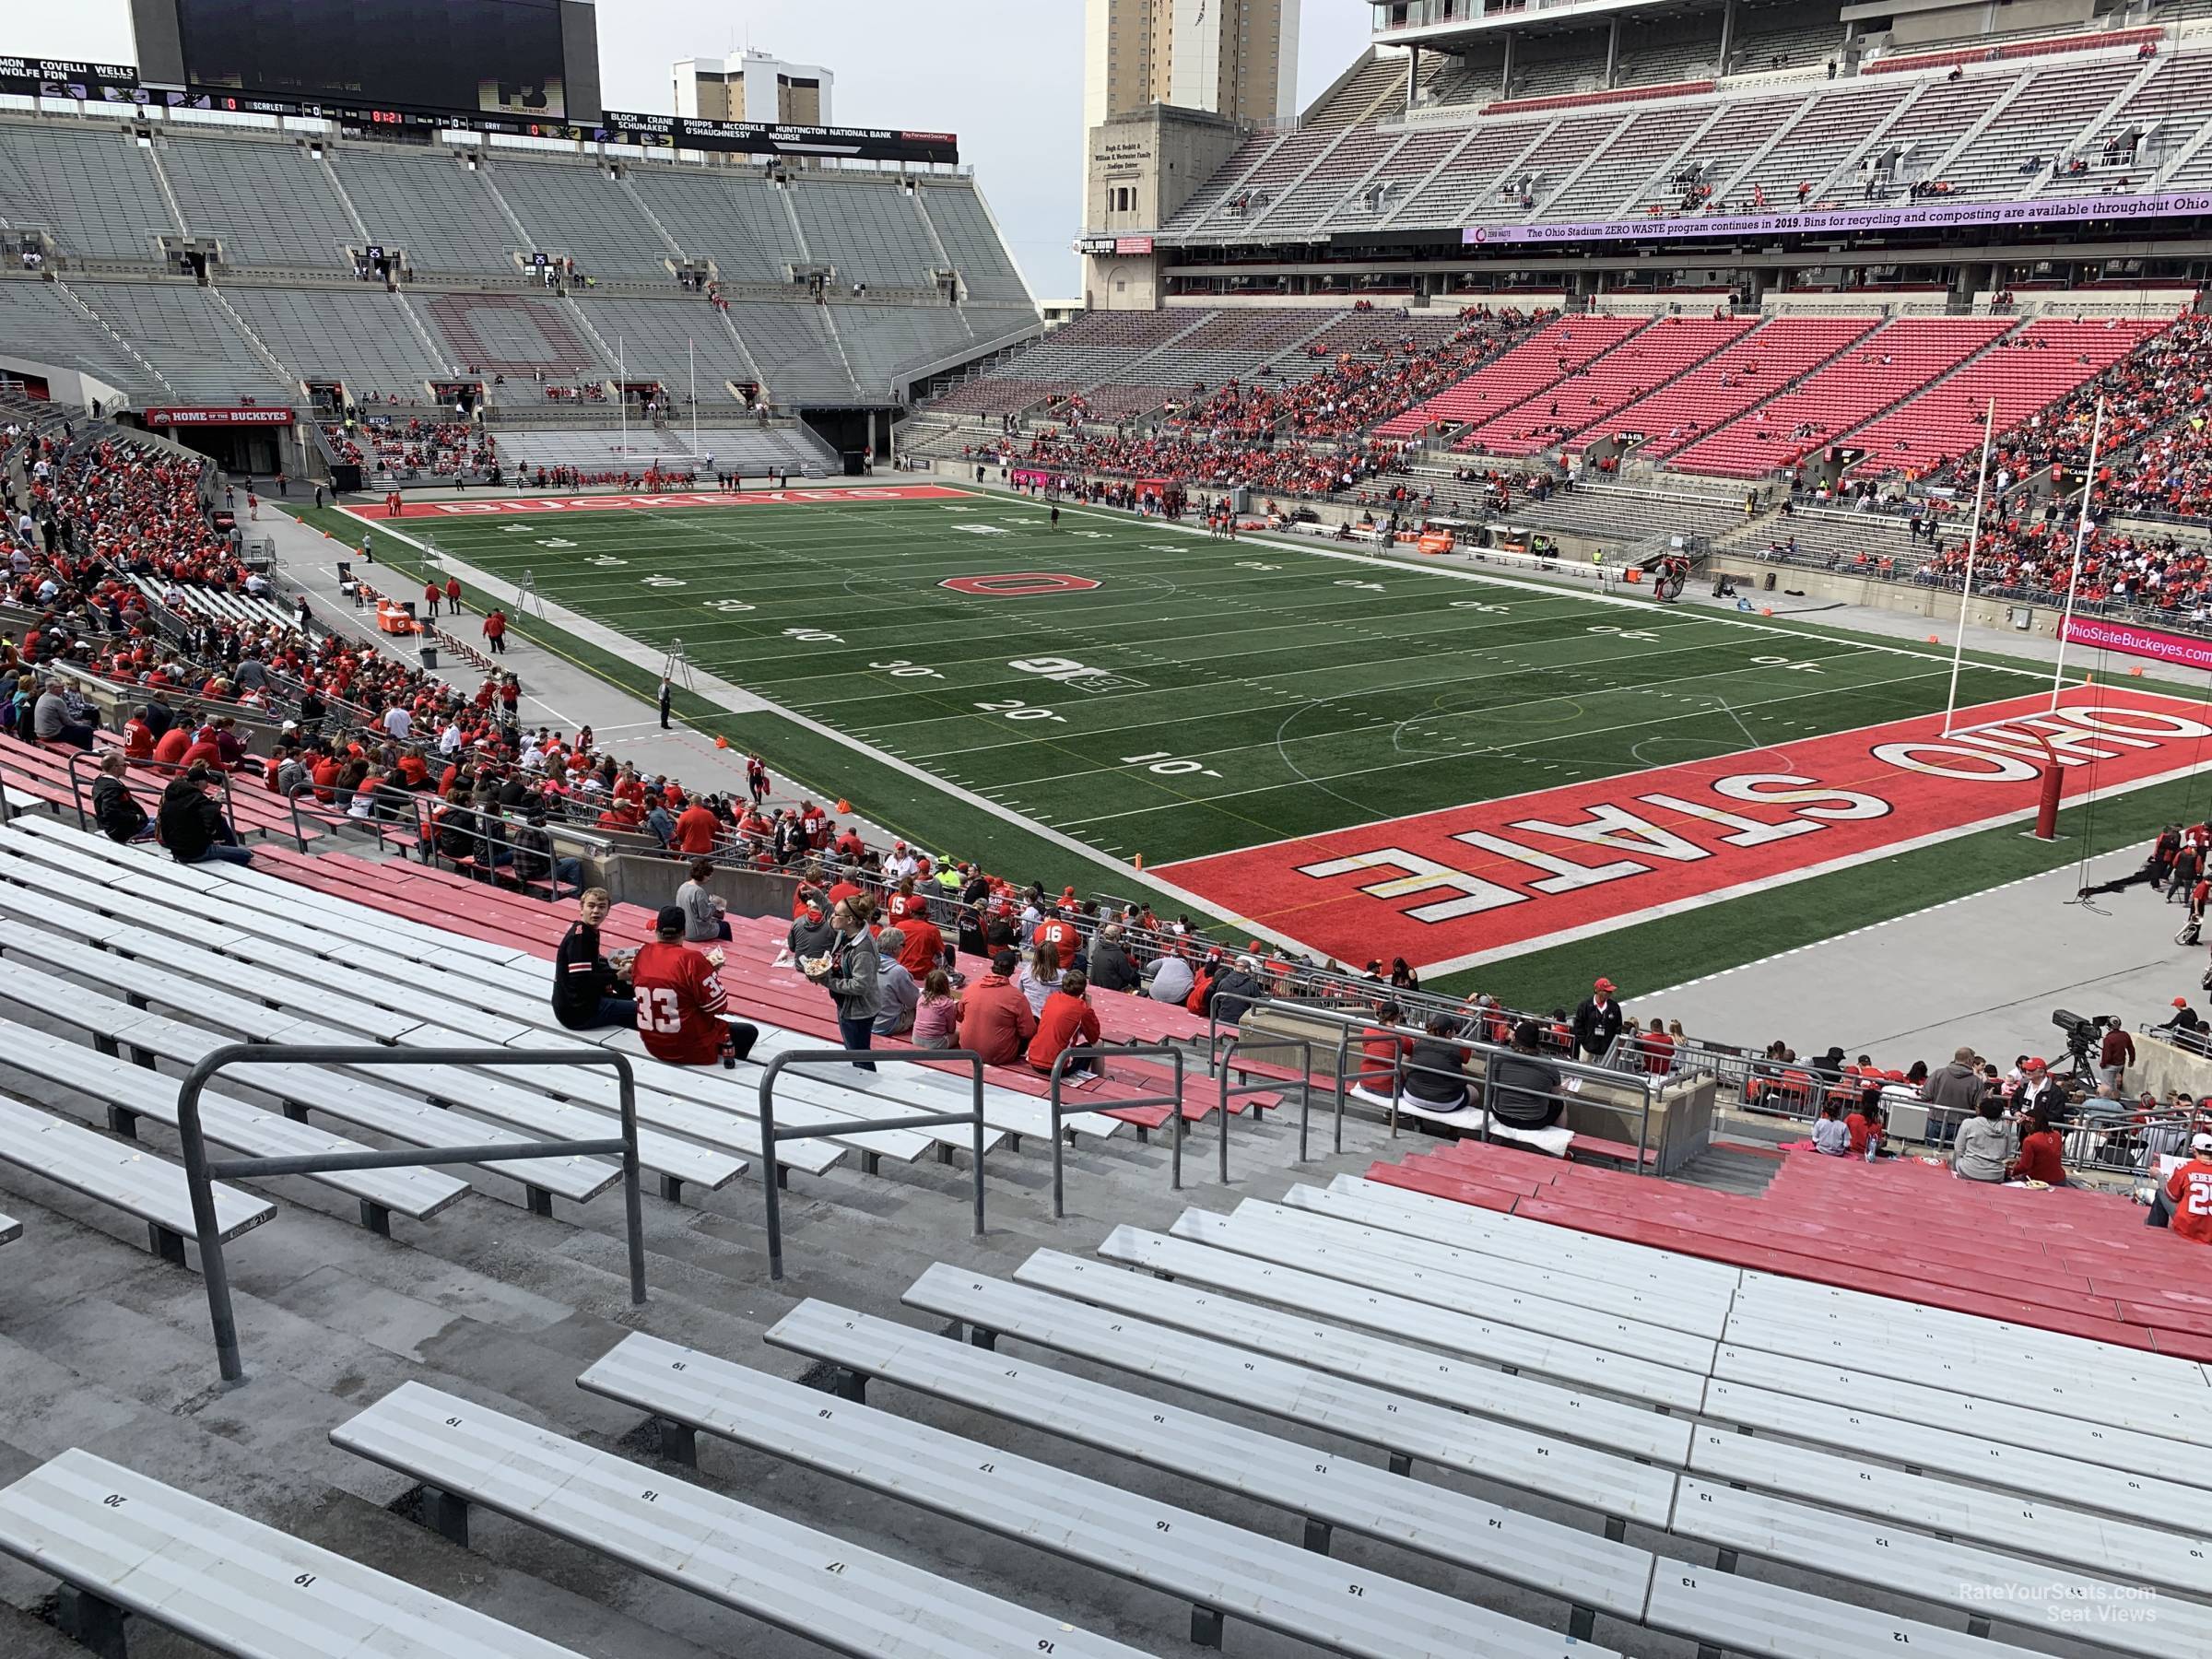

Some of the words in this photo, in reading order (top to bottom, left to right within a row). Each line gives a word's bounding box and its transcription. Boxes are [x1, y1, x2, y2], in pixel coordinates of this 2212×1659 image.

[40, 61, 88, 73] COVELLI
[94, 65, 134, 76] WELLS
[0, 67, 41, 78] WOLFE
[43, 71, 67, 80] FDN
[253, 102, 284, 112] SCARLET
[610, 113, 638, 122] BLOCH
[647, 116, 674, 125] CRANE
[485, 122, 500, 130] GRAY
[531, 124, 539, 135] 0
[618, 122, 668, 133] SCHUMAKER
[683, 120, 713, 128] PHIPPS
[723, 123, 766, 132] McCORKLE
[686, 127, 750, 138] O'SHAUGHNESSY
[769, 133, 801, 141] NOURSE
[775, 125, 828, 135] HUNTINGTON
[830, 128, 868, 137] NATIONAL
[869, 131, 891, 139] BANK
[1527, 229, 1543, 238] The
[1545, 228, 1565, 237] Ohio
[1568, 227, 1603, 237] Stadium
[1605, 226, 1630, 235] ZERO
[1631, 224, 1665, 234] WASTE
[1667, 223, 1709, 235] program
[1712, 219, 1759, 231] continues
[1761, 219, 1771, 229] in
[1775, 218, 1801, 229] 2019.
[1804, 218, 1827, 228] Bins
[1830, 215, 1845, 227] for
[1847, 212, 1901, 228] recycling
[1904, 211, 1926, 223] and
[1929, 207, 2001, 224] composting
[2005, 208, 2025, 218] are
[2028, 203, 2088, 217] available
[2092, 198, 2170, 217] throughout
[2173, 197, 2209, 210] Ohio
[370, 248, 381, 258] 25
[535, 255, 546, 265] 25
[172, 412, 207, 421] HOME
[230, 412, 288, 421] BUCKEYES
[2069, 467, 2099, 477] CAMBA
[434, 489, 901, 513] BUCKEYES
[702, 599, 757, 612] 50
[397, 620, 405, 629] G
[782, 628, 838, 641] 40
[868, 660, 935, 677] 30
[972, 700, 1053, 720] 20
[1870, 706, 2212, 782] OHIO
[1119, 751, 1204, 774] 10
[1296, 772, 1893, 925] STATE
[890, 897, 906, 914] 15
[1045, 926, 1062, 942] 16
[634, 986, 682, 1033] 33
[2188, 1182, 2212, 1217] 2
[254, 1214, 266, 1225] 21
[672, 1361, 687, 1371] 19
[818, 1409, 833, 1419] 18
[445, 1417, 463, 1428] 19
[979, 1463, 994, 1474] 17
[103, 1494, 128, 1508] 20
[641, 1490, 659, 1502] 18
[1156, 1521, 1171, 1533] 16
[1488, 1518, 1502, 1529] 14
[1876, 1537, 1888, 1547] 12
[294, 1573, 317, 1588] 19
[1682, 1577, 1697, 1589] 13
[1348, 1584, 1364, 1597] 15
[1893, 1631, 1910, 1643] 12
[1038, 1640, 1055, 1654] 16
